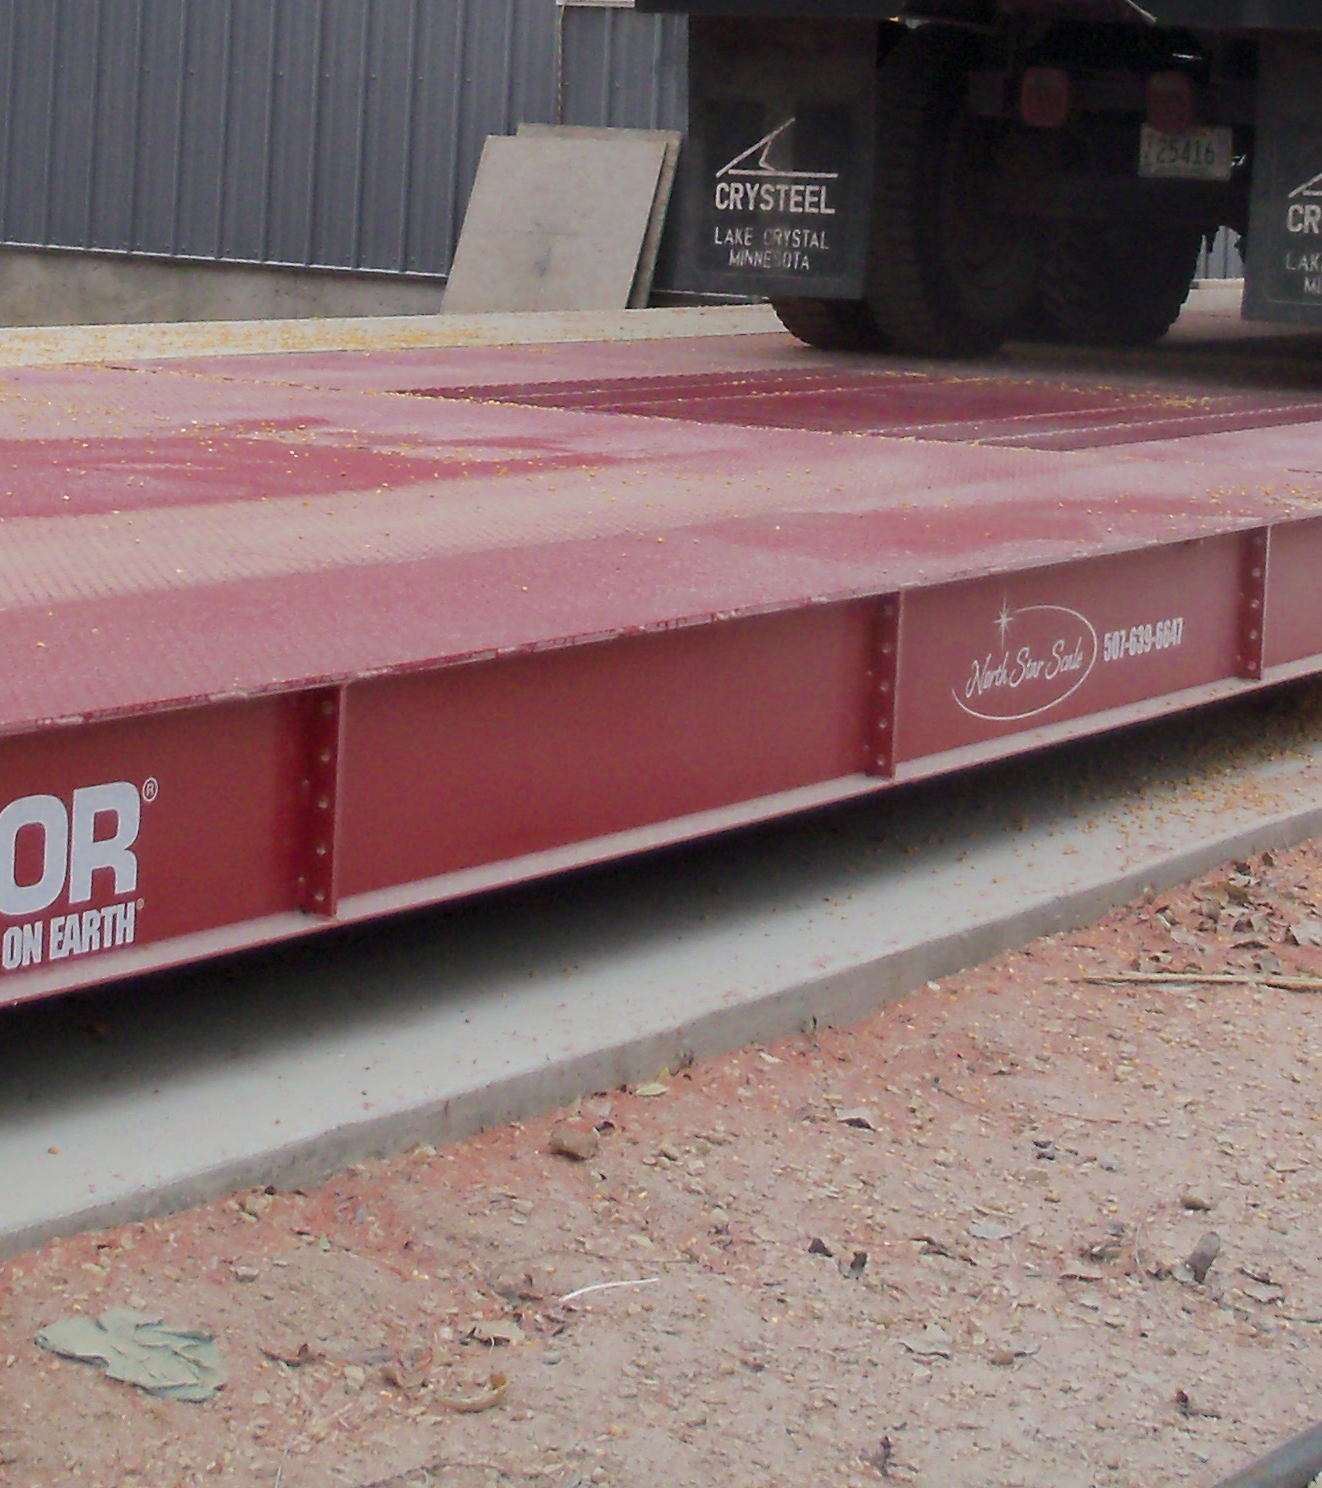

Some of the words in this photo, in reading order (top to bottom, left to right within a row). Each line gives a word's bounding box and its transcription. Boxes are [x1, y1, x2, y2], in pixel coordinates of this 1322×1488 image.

[715, 182, 836, 214] CRYSTEEL
[714, 226, 754, 246] LAKE
[763, 228, 830, 250] CRYSTAL
[965, 651, 1009, 699] North
[1009, 646, 1044, 688] Star
[1045, 636, 1084, 680] Scale
[1, 921, 44, 971] ON
[49, 905, 136, 961] EARTH
